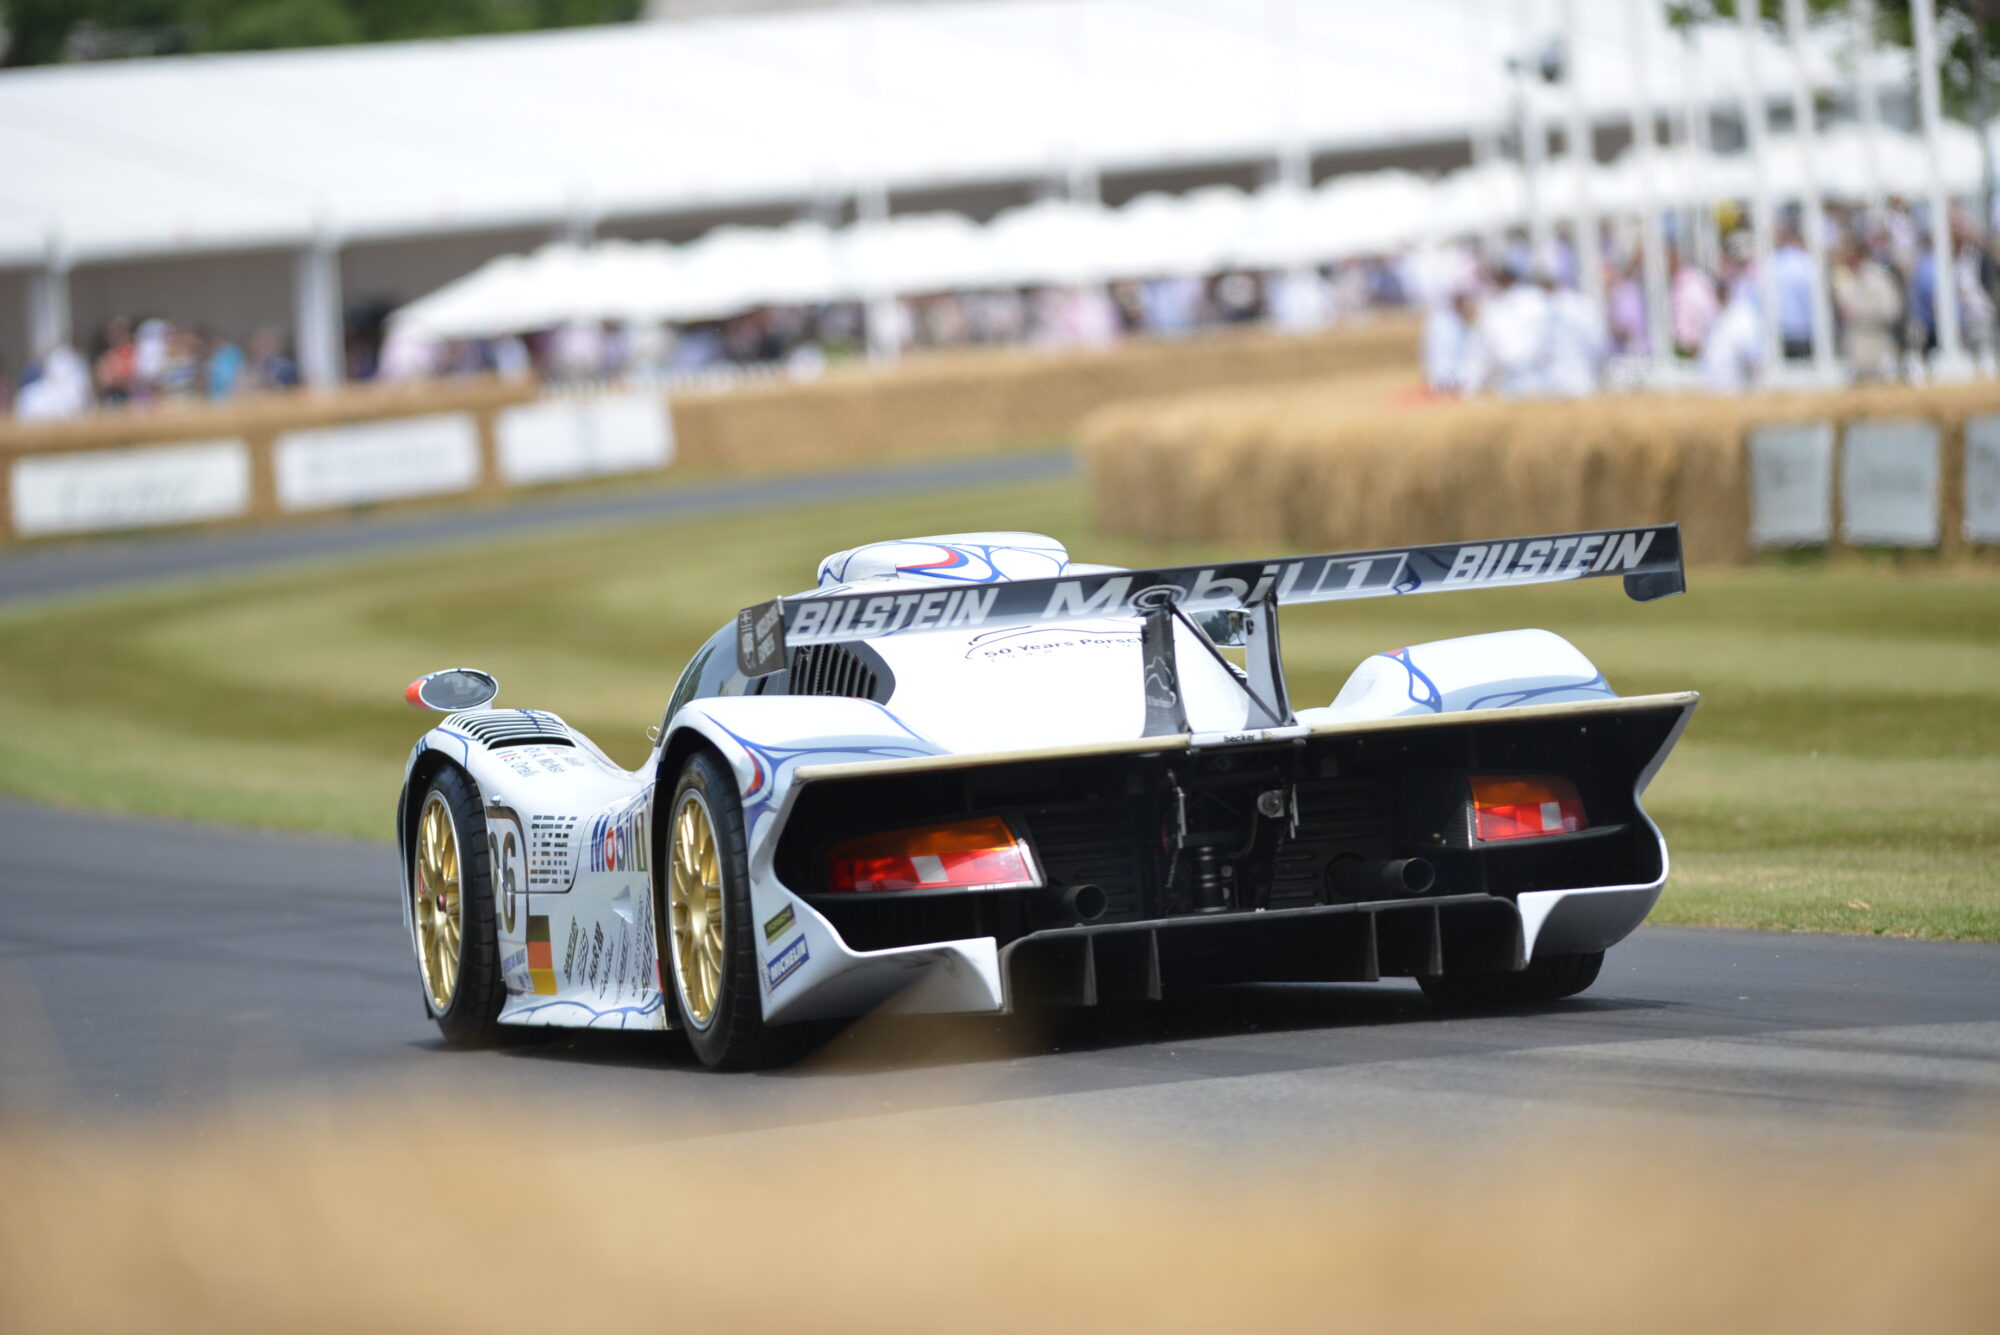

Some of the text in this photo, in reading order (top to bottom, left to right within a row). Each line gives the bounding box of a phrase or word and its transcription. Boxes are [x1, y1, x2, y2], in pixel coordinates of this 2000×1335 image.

[1442, 532, 1656, 585] BILSTEIN
[786, 588, 999, 638] BILSTEIN
[1041, 560, 1373, 618] Mobil 1
[984, 648, 1011, 657] 50
[1016, 641, 1074, 651] Years
[530, 814, 578, 884] IBM
[591, 811, 634, 872] Mobil
